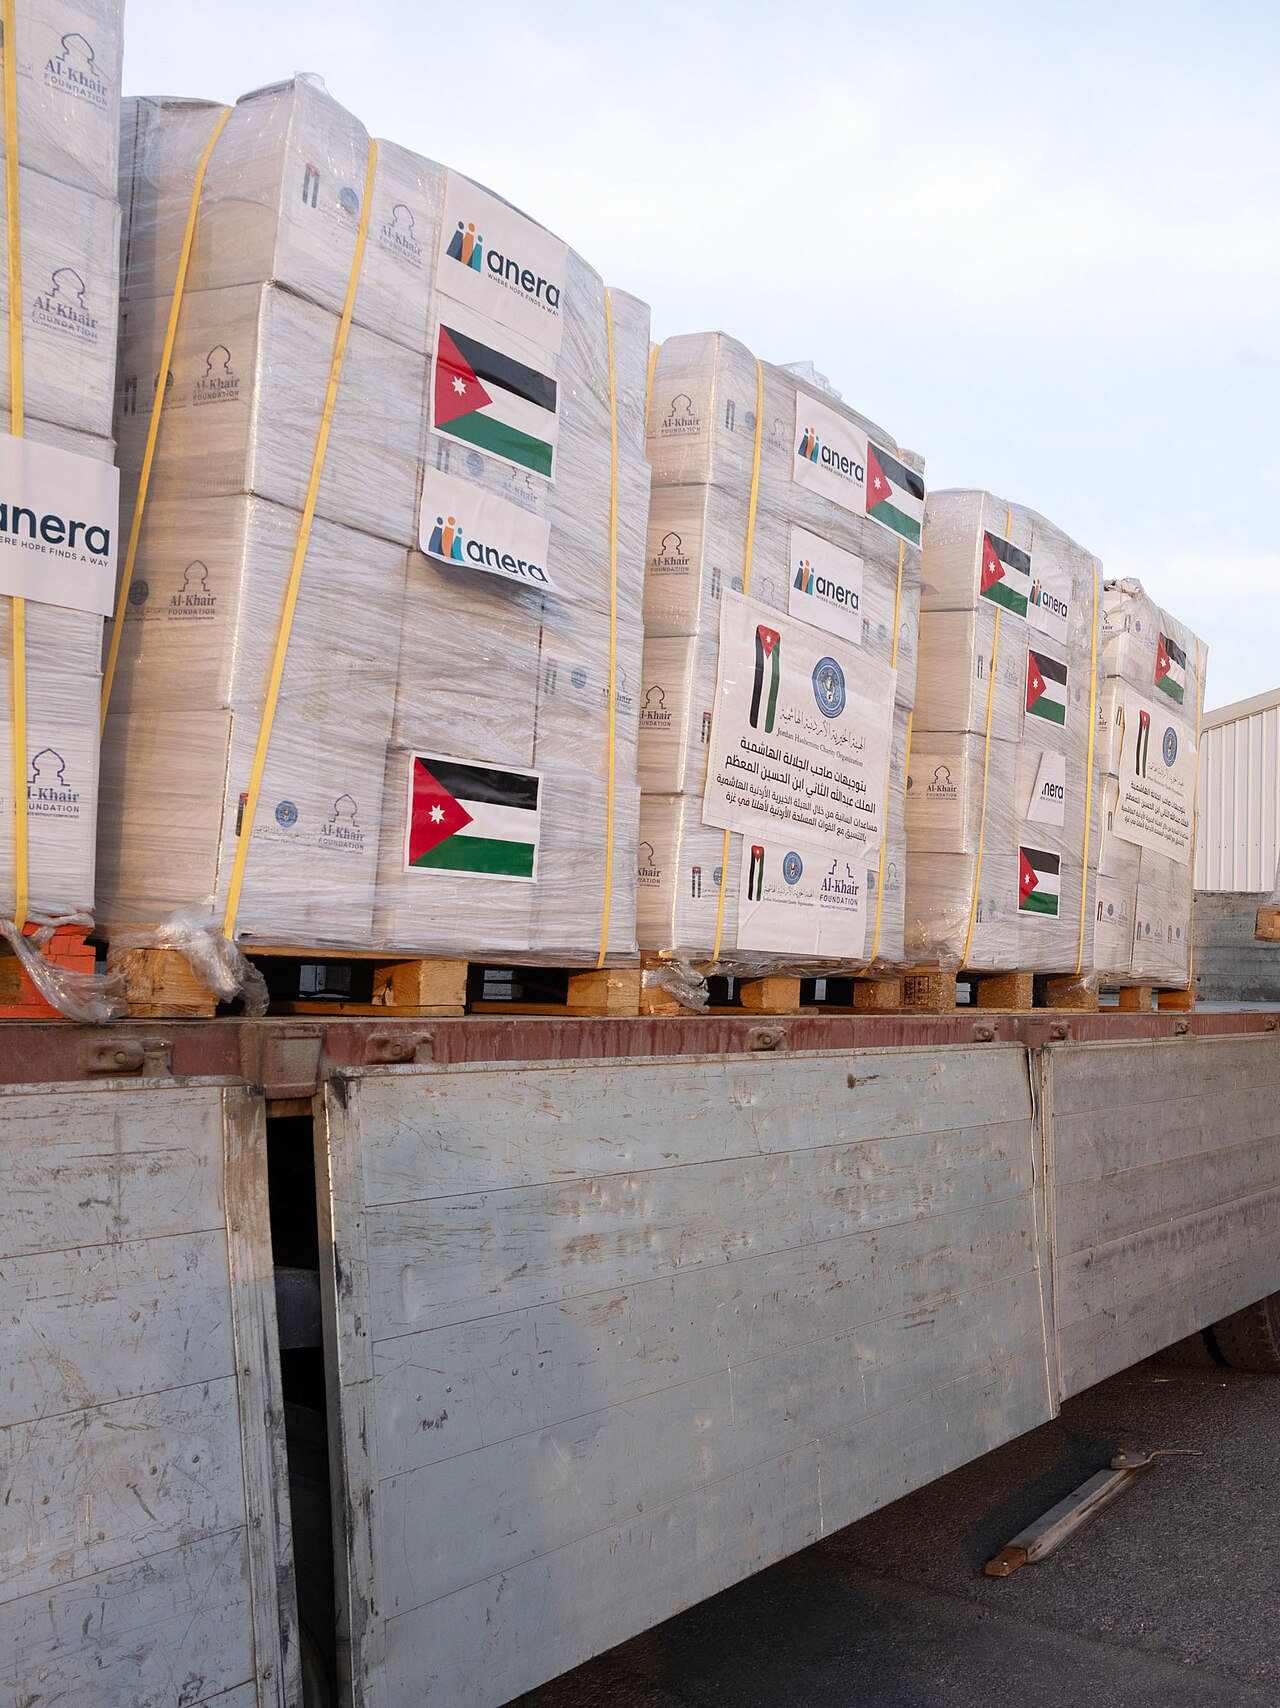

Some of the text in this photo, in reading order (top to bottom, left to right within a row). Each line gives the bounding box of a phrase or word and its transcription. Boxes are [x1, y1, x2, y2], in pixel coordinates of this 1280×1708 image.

[44, 58, 108, 97] Al-Khair
[44, 73, 108, 107] FOUNDATION
[380, 225, 423, 257] Al-Khair
[487, 250, 560, 308] anera
[487, 272, 508, 289] WHERE
[509, 285, 525, 298] HOPE
[32, 296, 99, 330] Al-Khair
[32, 307, 98, 340] FOUNDATION
[661, 417, 701, 429] Al-Khair
[822, 446, 864, 483] anera
[0, 503, 110, 557] nera
[21, 540, 109, 568] HOPE FINDS A WAY
[466, 540, 549, 583] anera
[651, 556, 690, 567] Al-Khair
[169, 592, 217, 607] Al-Khair
[816, 576, 859, 611] anera
[168, 608, 215, 616] FOUNDATION
[1042, 592, 1068, 618] anera
[640, 710, 672, 720] l-Khair
[776, 727, 863, 768] Jordan Hashemite Charity Organization
[740, 736, 867, 796] بتوجيهات صاحب الجلالة الهاشمية
[716, 773, 749, 792] الهاشمية
[725, 754, 876, 814] الملك عبدالله الثاني ابن الحسين المعظم
[749, 783, 771, 800] الأردنية
[926, 784, 957, 793] Al-Khair
[1041, 782, 1064, 799] nera
[27, 786, 80, 803] l-Khair
[771, 791, 793, 806] الخيرية
[28, 803, 80, 813] UNDATION
[794, 797, 812, 812] الهيئة
[812, 804, 825, 816] خلال
[725, 791, 867, 845] بالتنسيق مع القوات المسلحة الأردنية لأهلنا في غزة
[825, 811, 834, 820] من
[320, 823, 367, 843] Al-Khair
[853, 818, 878, 833] مساعدات
[317, 836, 365, 850] FOUNDATION
[820, 878, 860, 896] Al-Khair
[819, 895, 858, 906] FOUNDATION
